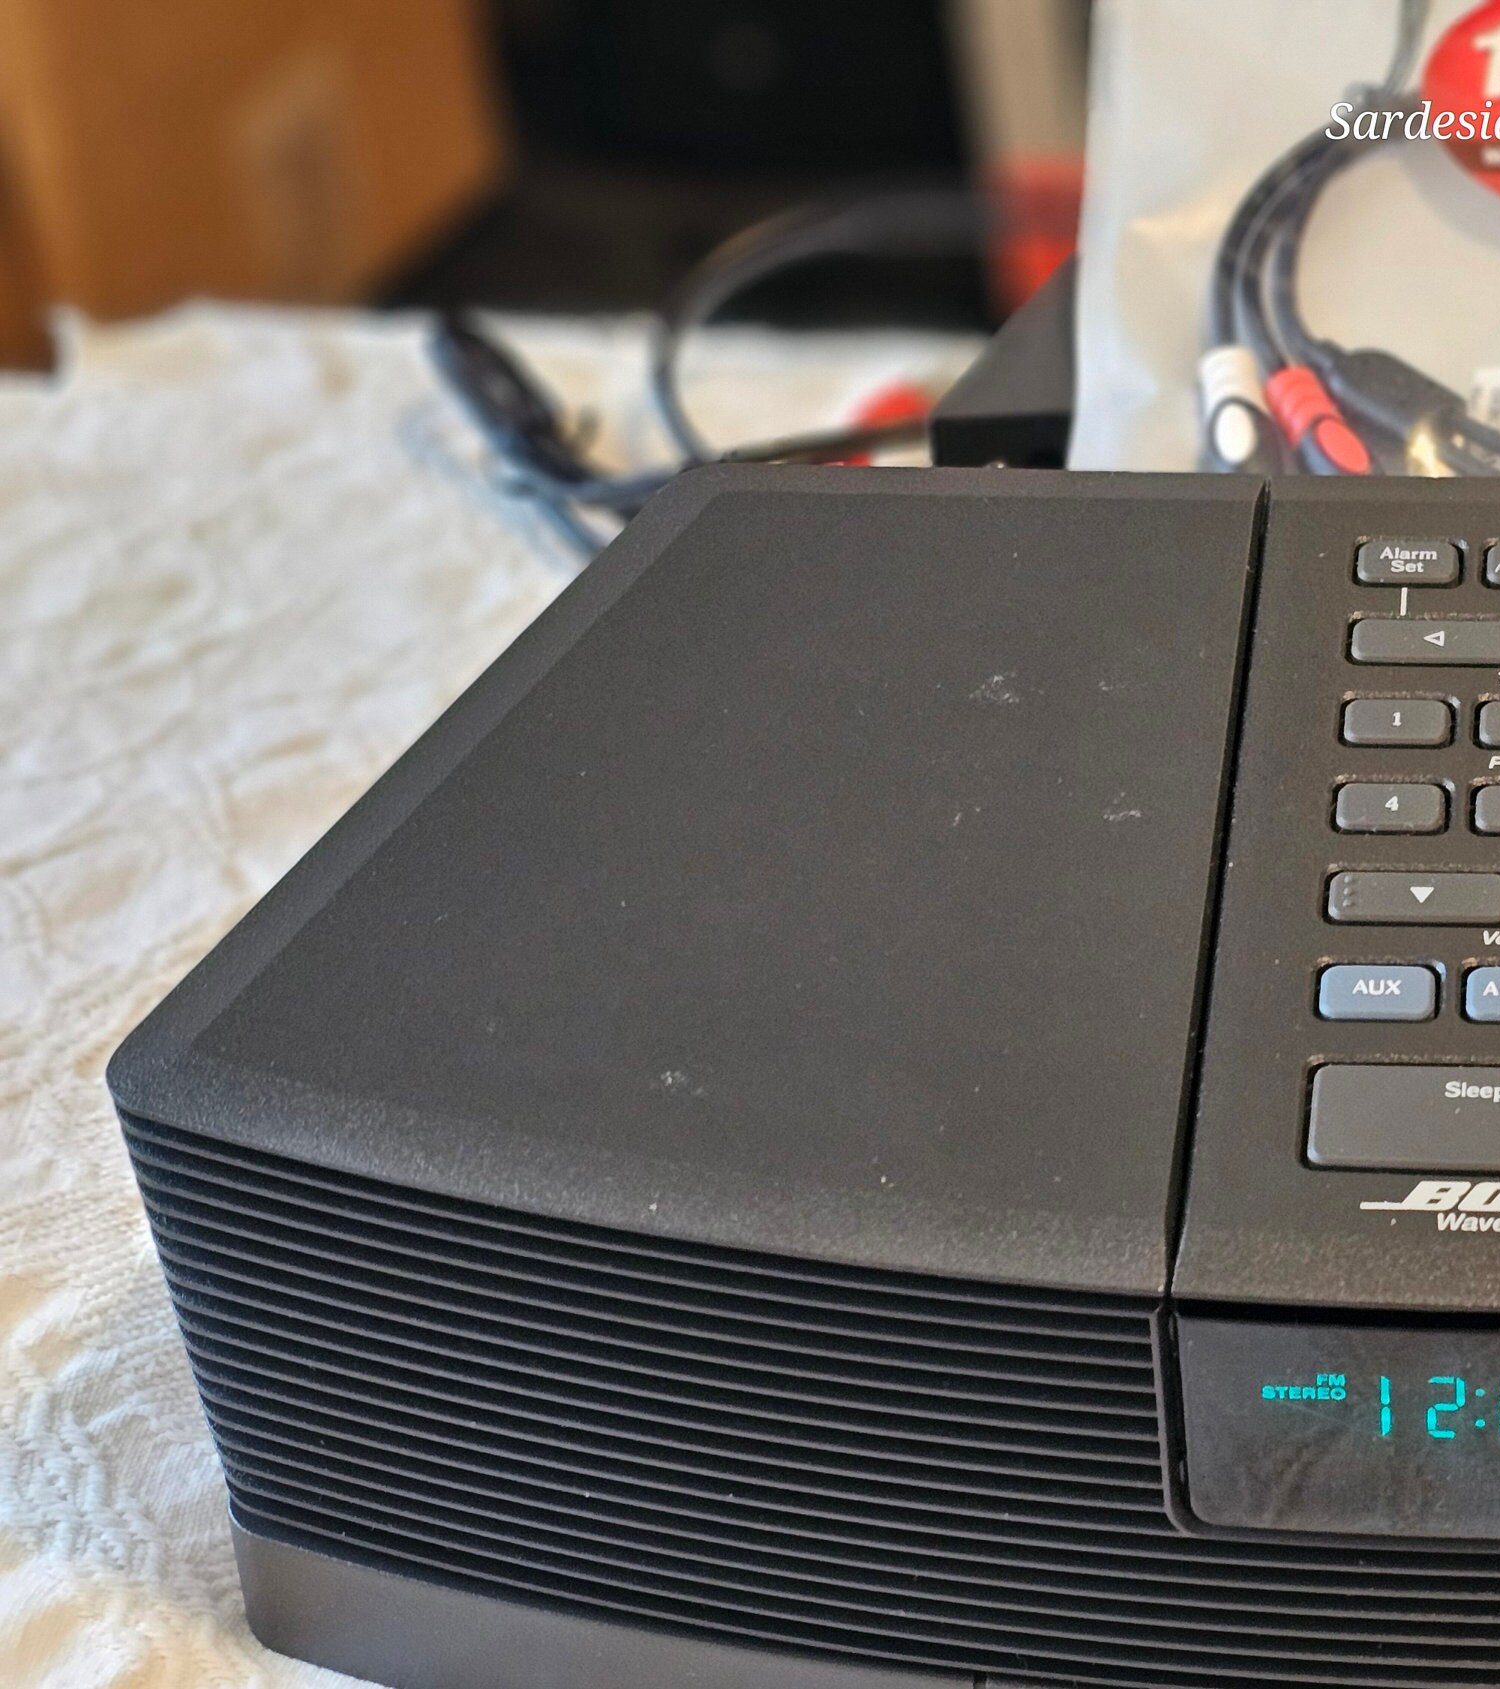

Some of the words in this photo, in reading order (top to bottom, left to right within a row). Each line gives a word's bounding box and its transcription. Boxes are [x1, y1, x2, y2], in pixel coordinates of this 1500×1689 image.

[1379, 546, 1437, 560] Alarm
[1391, 560, 1424, 573] Set
[1391, 711, 1402, 726] 1
[1384, 796, 1398, 811] 4
[1352, 979, 1402, 996] AUX
[1316, 1373, 1346, 1386] FM
[1262, 1385, 1347, 1401] STEREO
